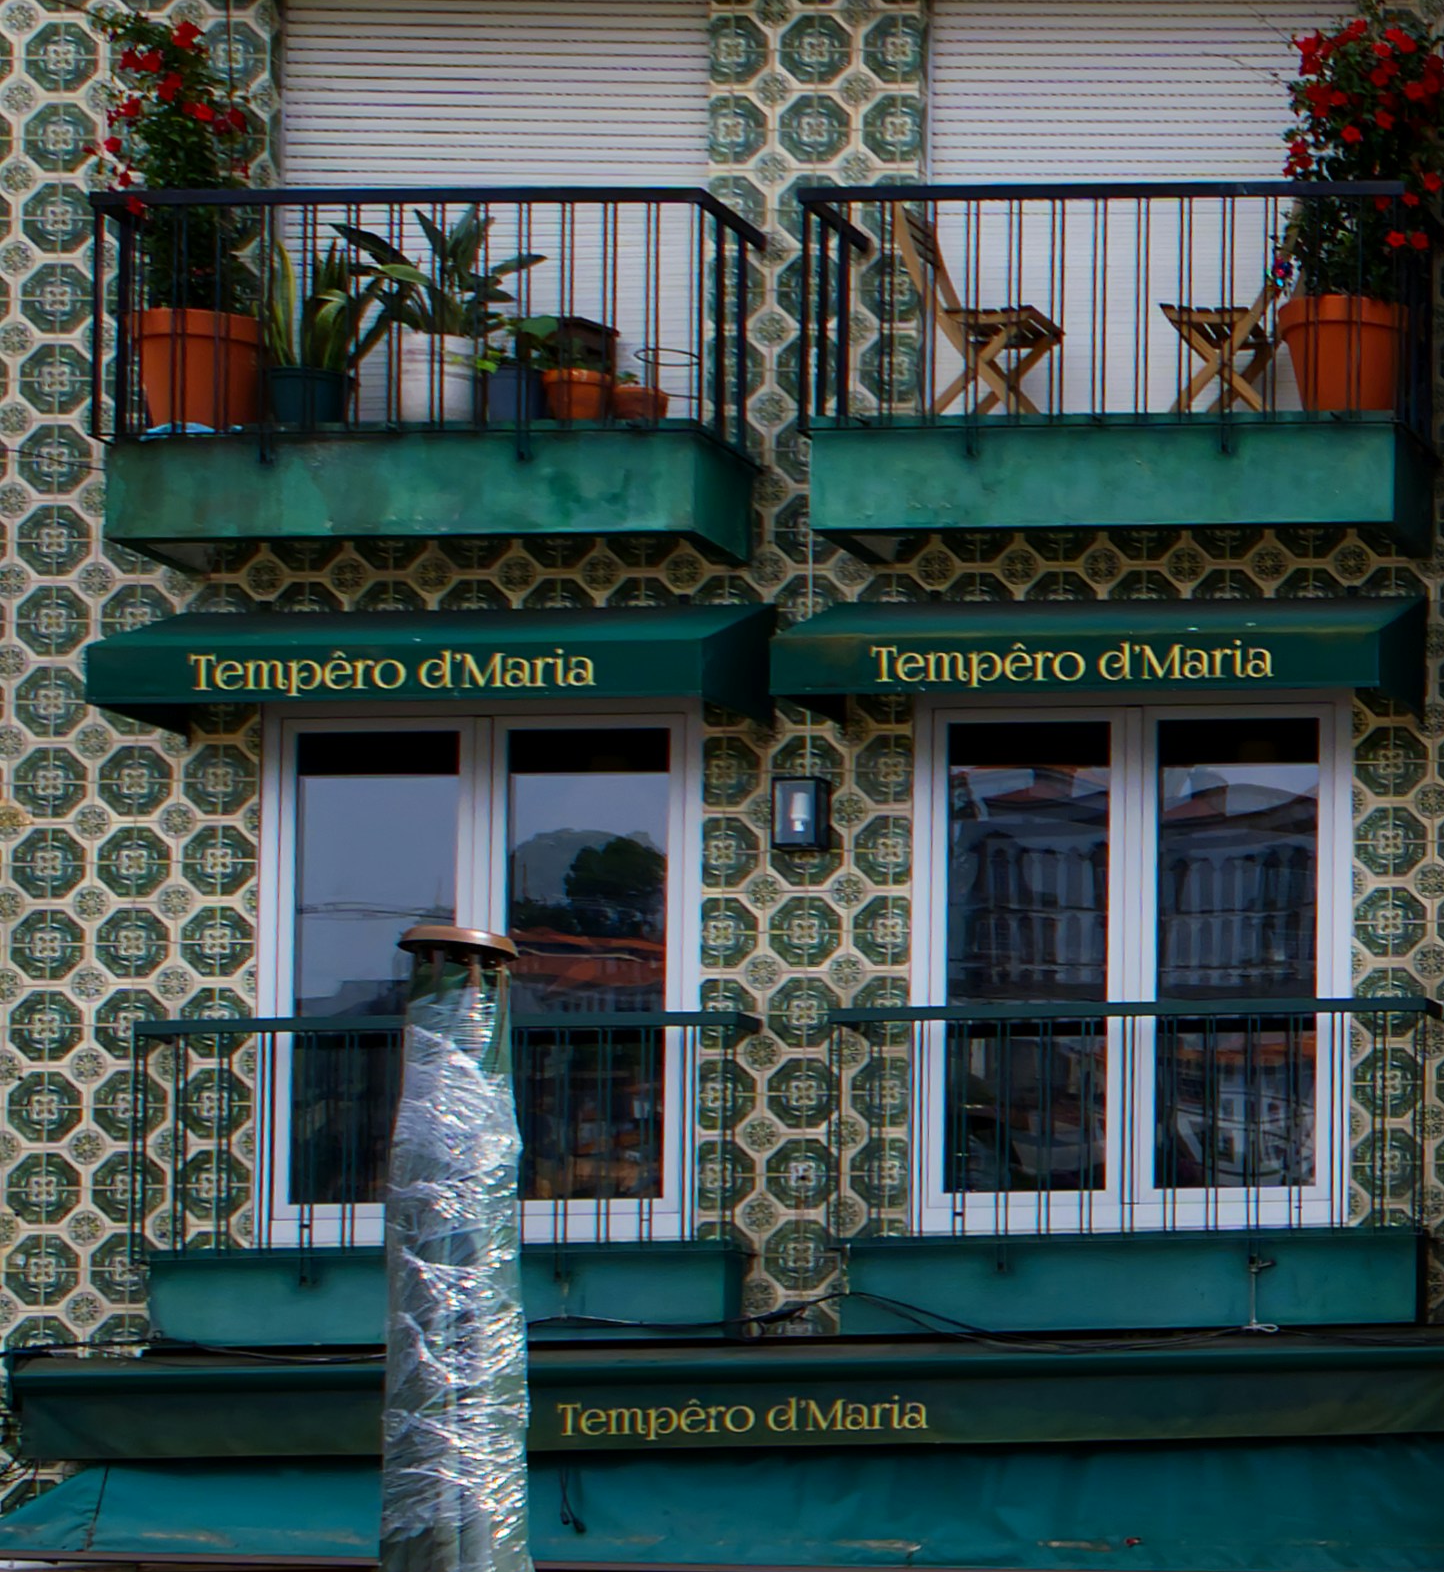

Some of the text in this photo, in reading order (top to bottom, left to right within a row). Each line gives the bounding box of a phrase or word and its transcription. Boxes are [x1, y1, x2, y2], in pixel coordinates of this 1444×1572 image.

[189, 649, 596, 697] Tempêro d'Maria
[870, 640, 1273, 689] Tempêro d'Maria
[557, 1395, 928, 1441] Tempêro d'Maria
